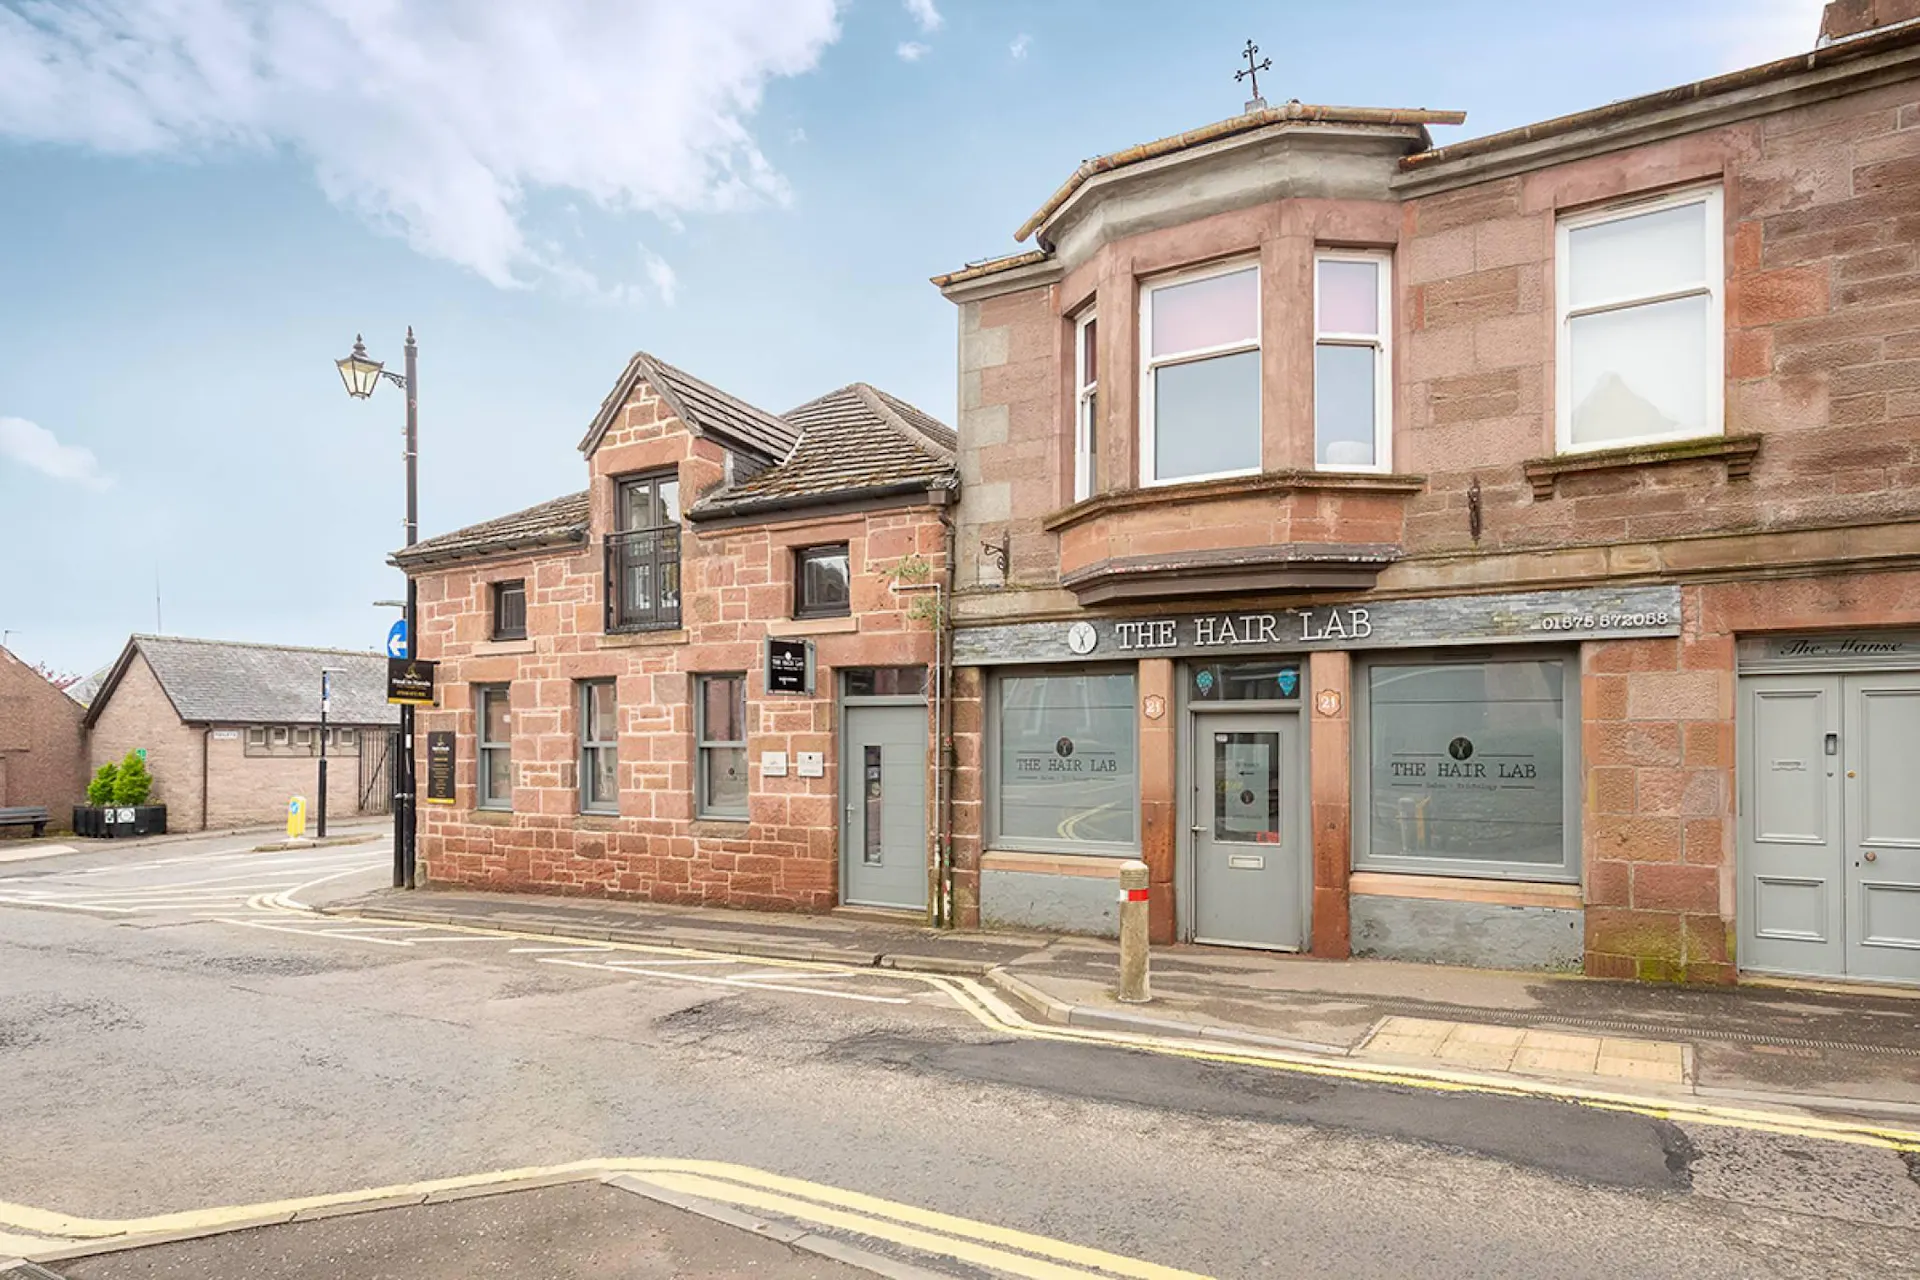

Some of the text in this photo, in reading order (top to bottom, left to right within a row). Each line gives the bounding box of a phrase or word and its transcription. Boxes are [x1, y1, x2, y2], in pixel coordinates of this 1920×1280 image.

[1115, 609, 1372, 649] THE HAIR LAB
[1780, 639, 1821, 655] The
[1145, 702, 1161, 714] 21
[1320, 696, 1336, 709] 21
[1016, 758, 1118, 772] THE HAIR LAB
[1391, 762, 1537, 779] THE HAIR LAB
